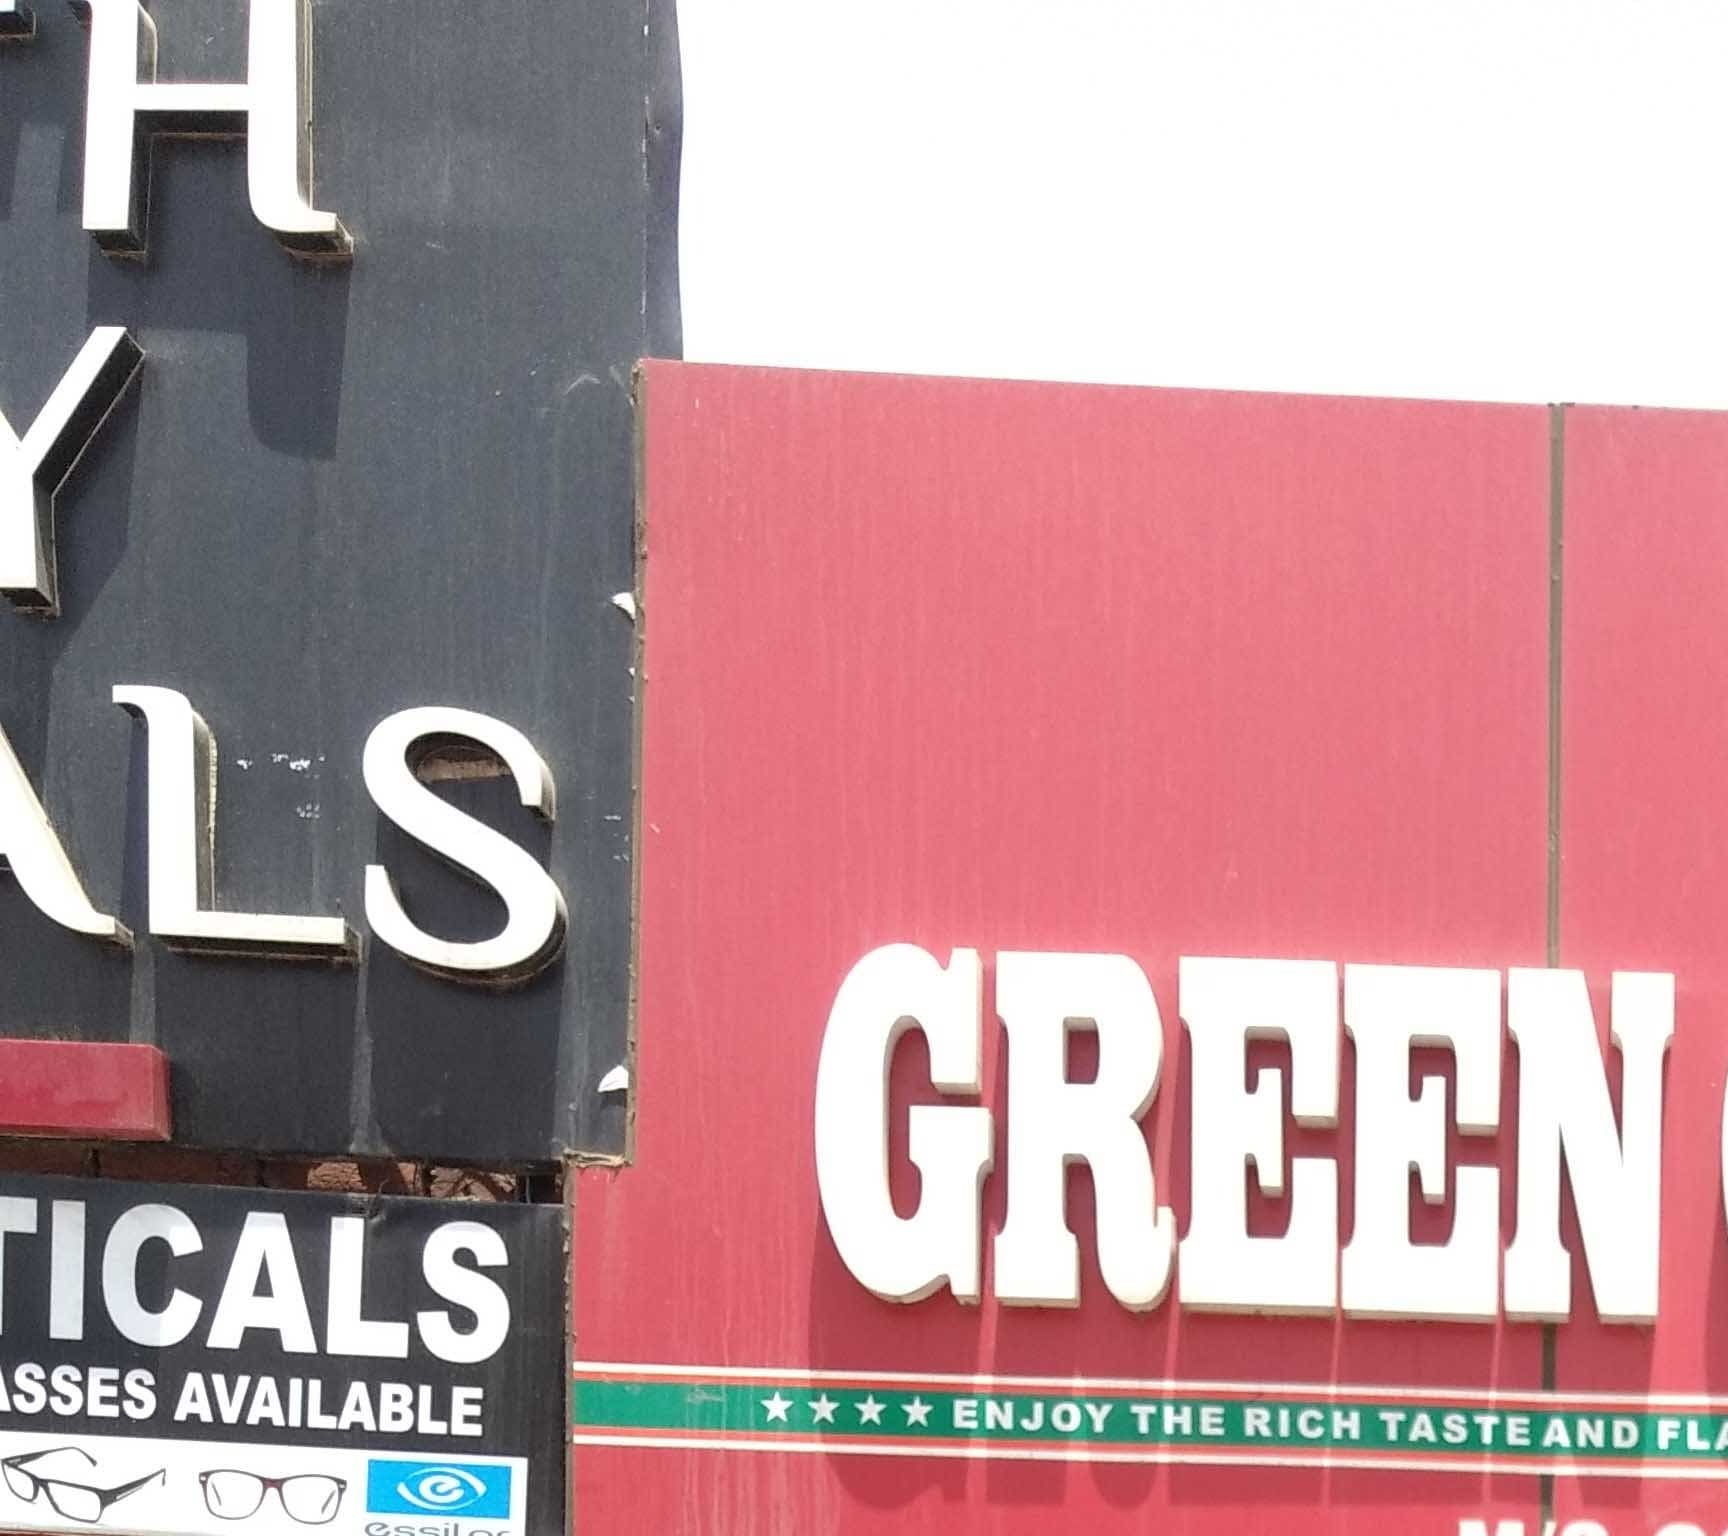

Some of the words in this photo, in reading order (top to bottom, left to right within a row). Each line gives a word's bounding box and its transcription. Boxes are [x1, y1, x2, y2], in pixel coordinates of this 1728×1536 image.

[0, 0, 340, 236] H
[814, 942, 1676, 1326] GREEN
[0, 1361, 157, 1420] SSES
[174, 1371, 484, 1437] AVAILABLE
[952, 1397, 1113, 1434] ENJOY
[1130, 1403, 1226, 1437] THE
[1243, 1404, 1361, 1441] RICH
[1378, 1411, 1530, 1448] TASTE
[1541, 1417, 1640, 1451] AND
